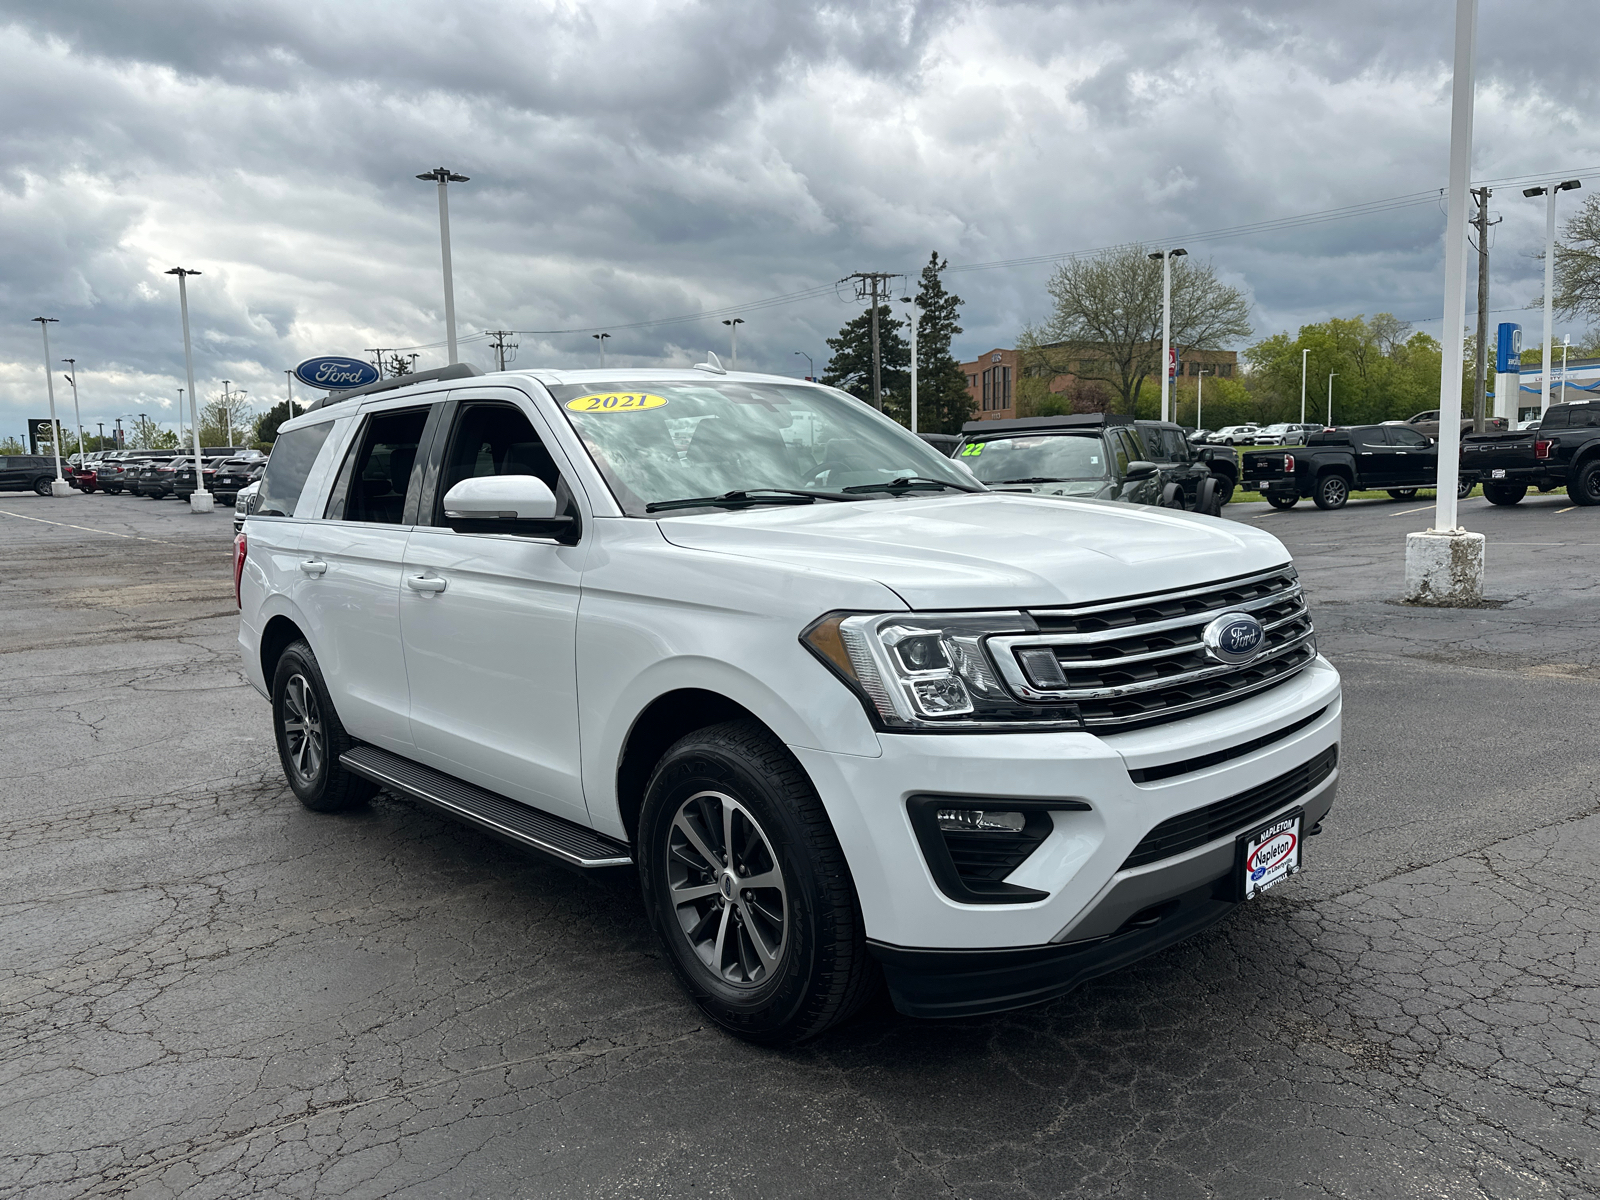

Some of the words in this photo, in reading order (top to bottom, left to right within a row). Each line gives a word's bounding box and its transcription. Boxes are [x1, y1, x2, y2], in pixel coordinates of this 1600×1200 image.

[315, 362, 363, 383] Ford
[585, 395, 647, 410] 2021
[961, 442, 986, 457] 22
[1230, 625, 1258, 650] Ford
[1260, 819, 1293, 843] NAPLETON
[1255, 841, 1289, 867] Napleton
